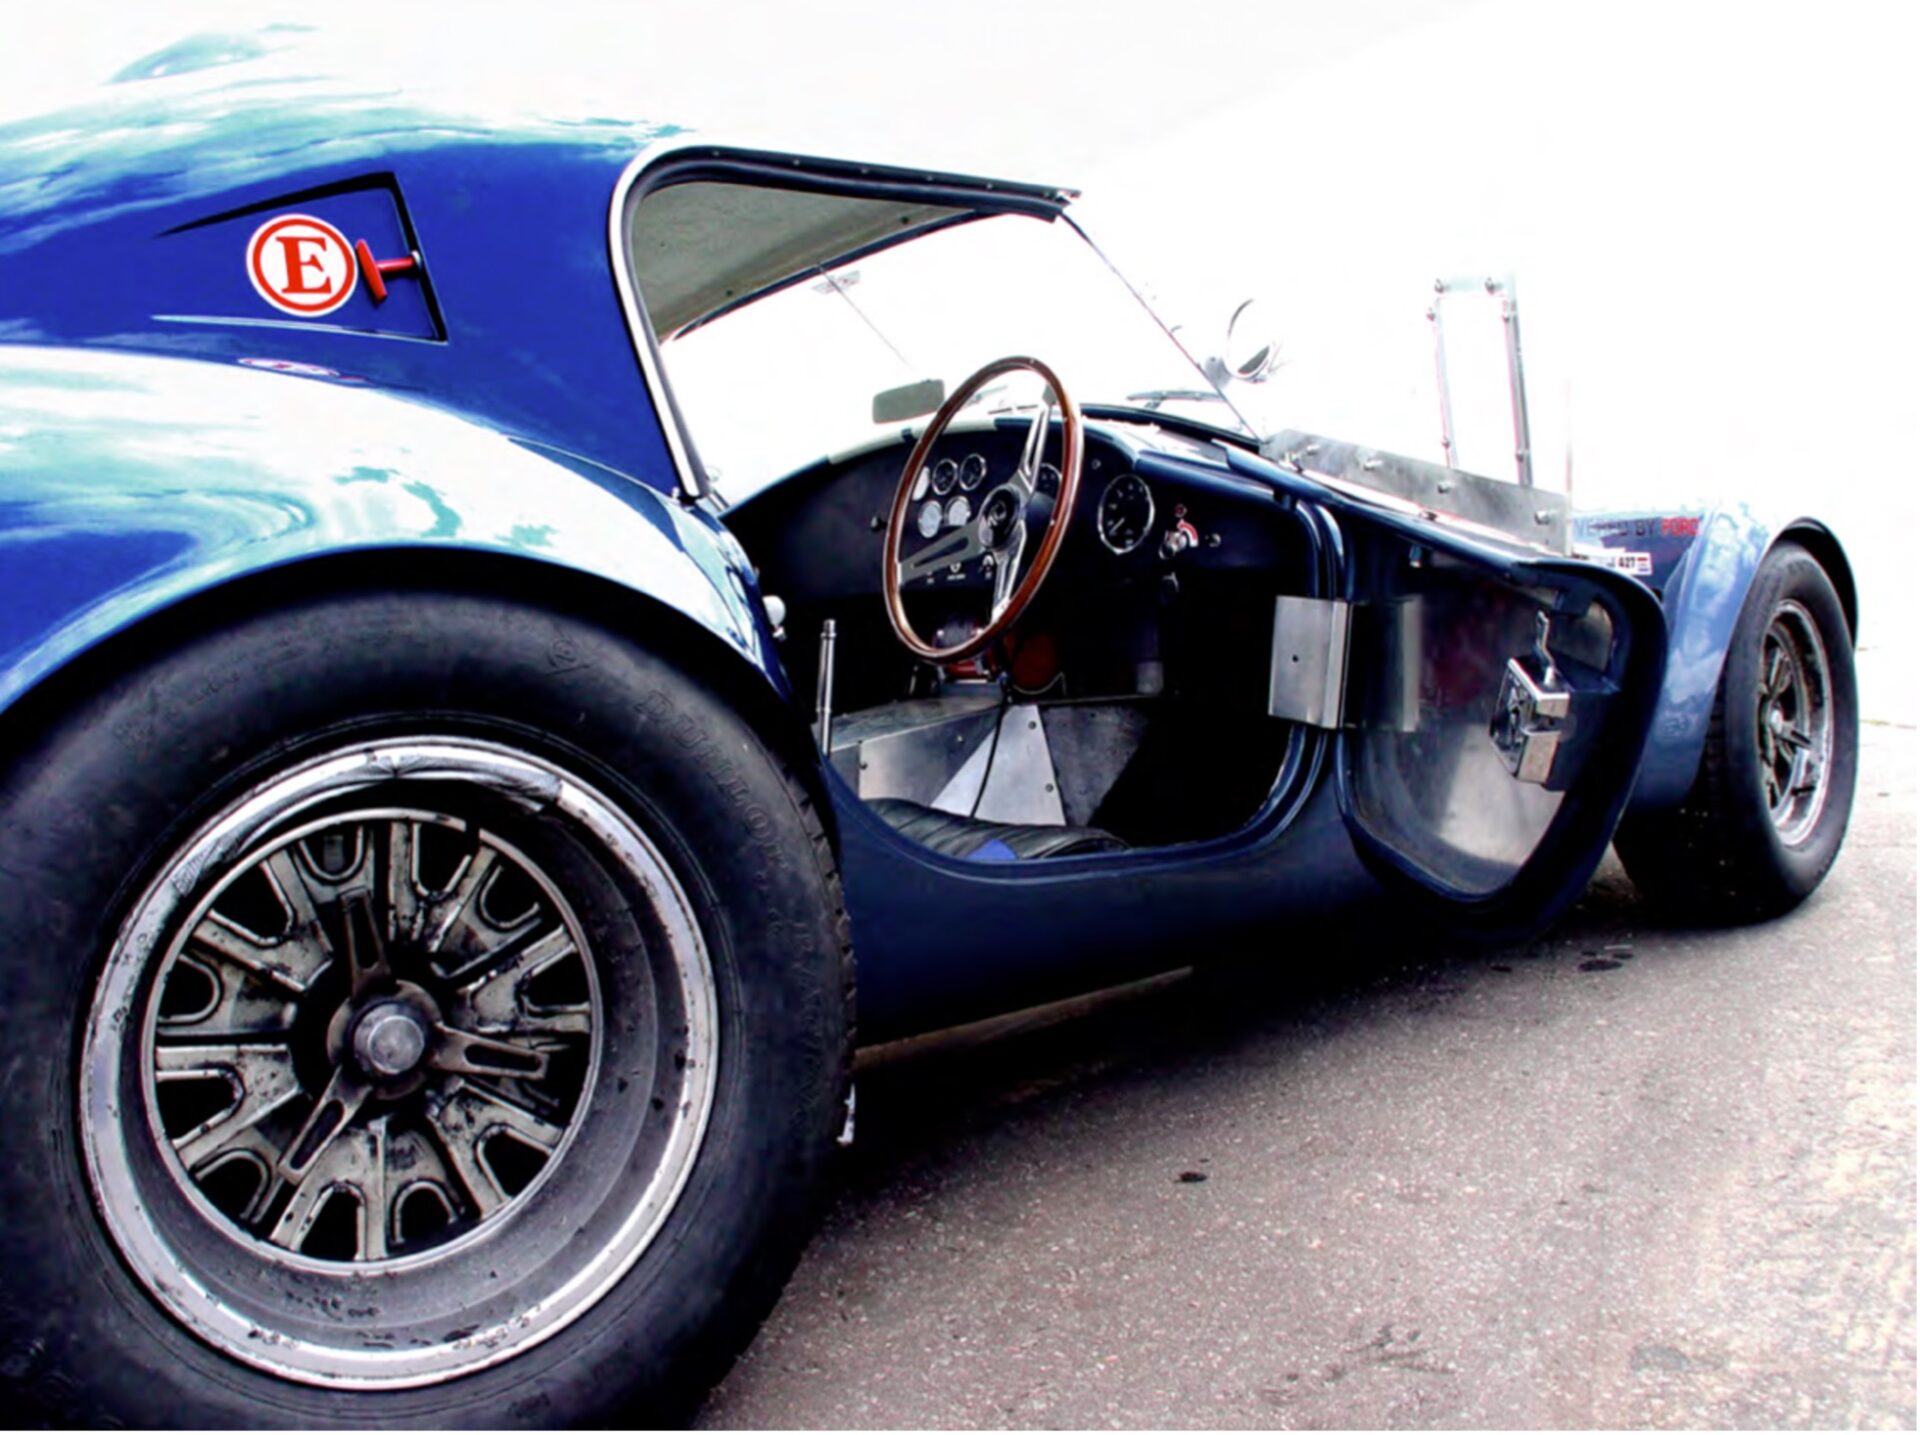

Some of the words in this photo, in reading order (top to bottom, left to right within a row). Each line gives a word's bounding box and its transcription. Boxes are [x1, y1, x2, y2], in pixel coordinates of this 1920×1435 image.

[276, 236, 333, 294] E
[1635, 518, 1657, 537] BY
[1618, 556, 1637, 569] 427
